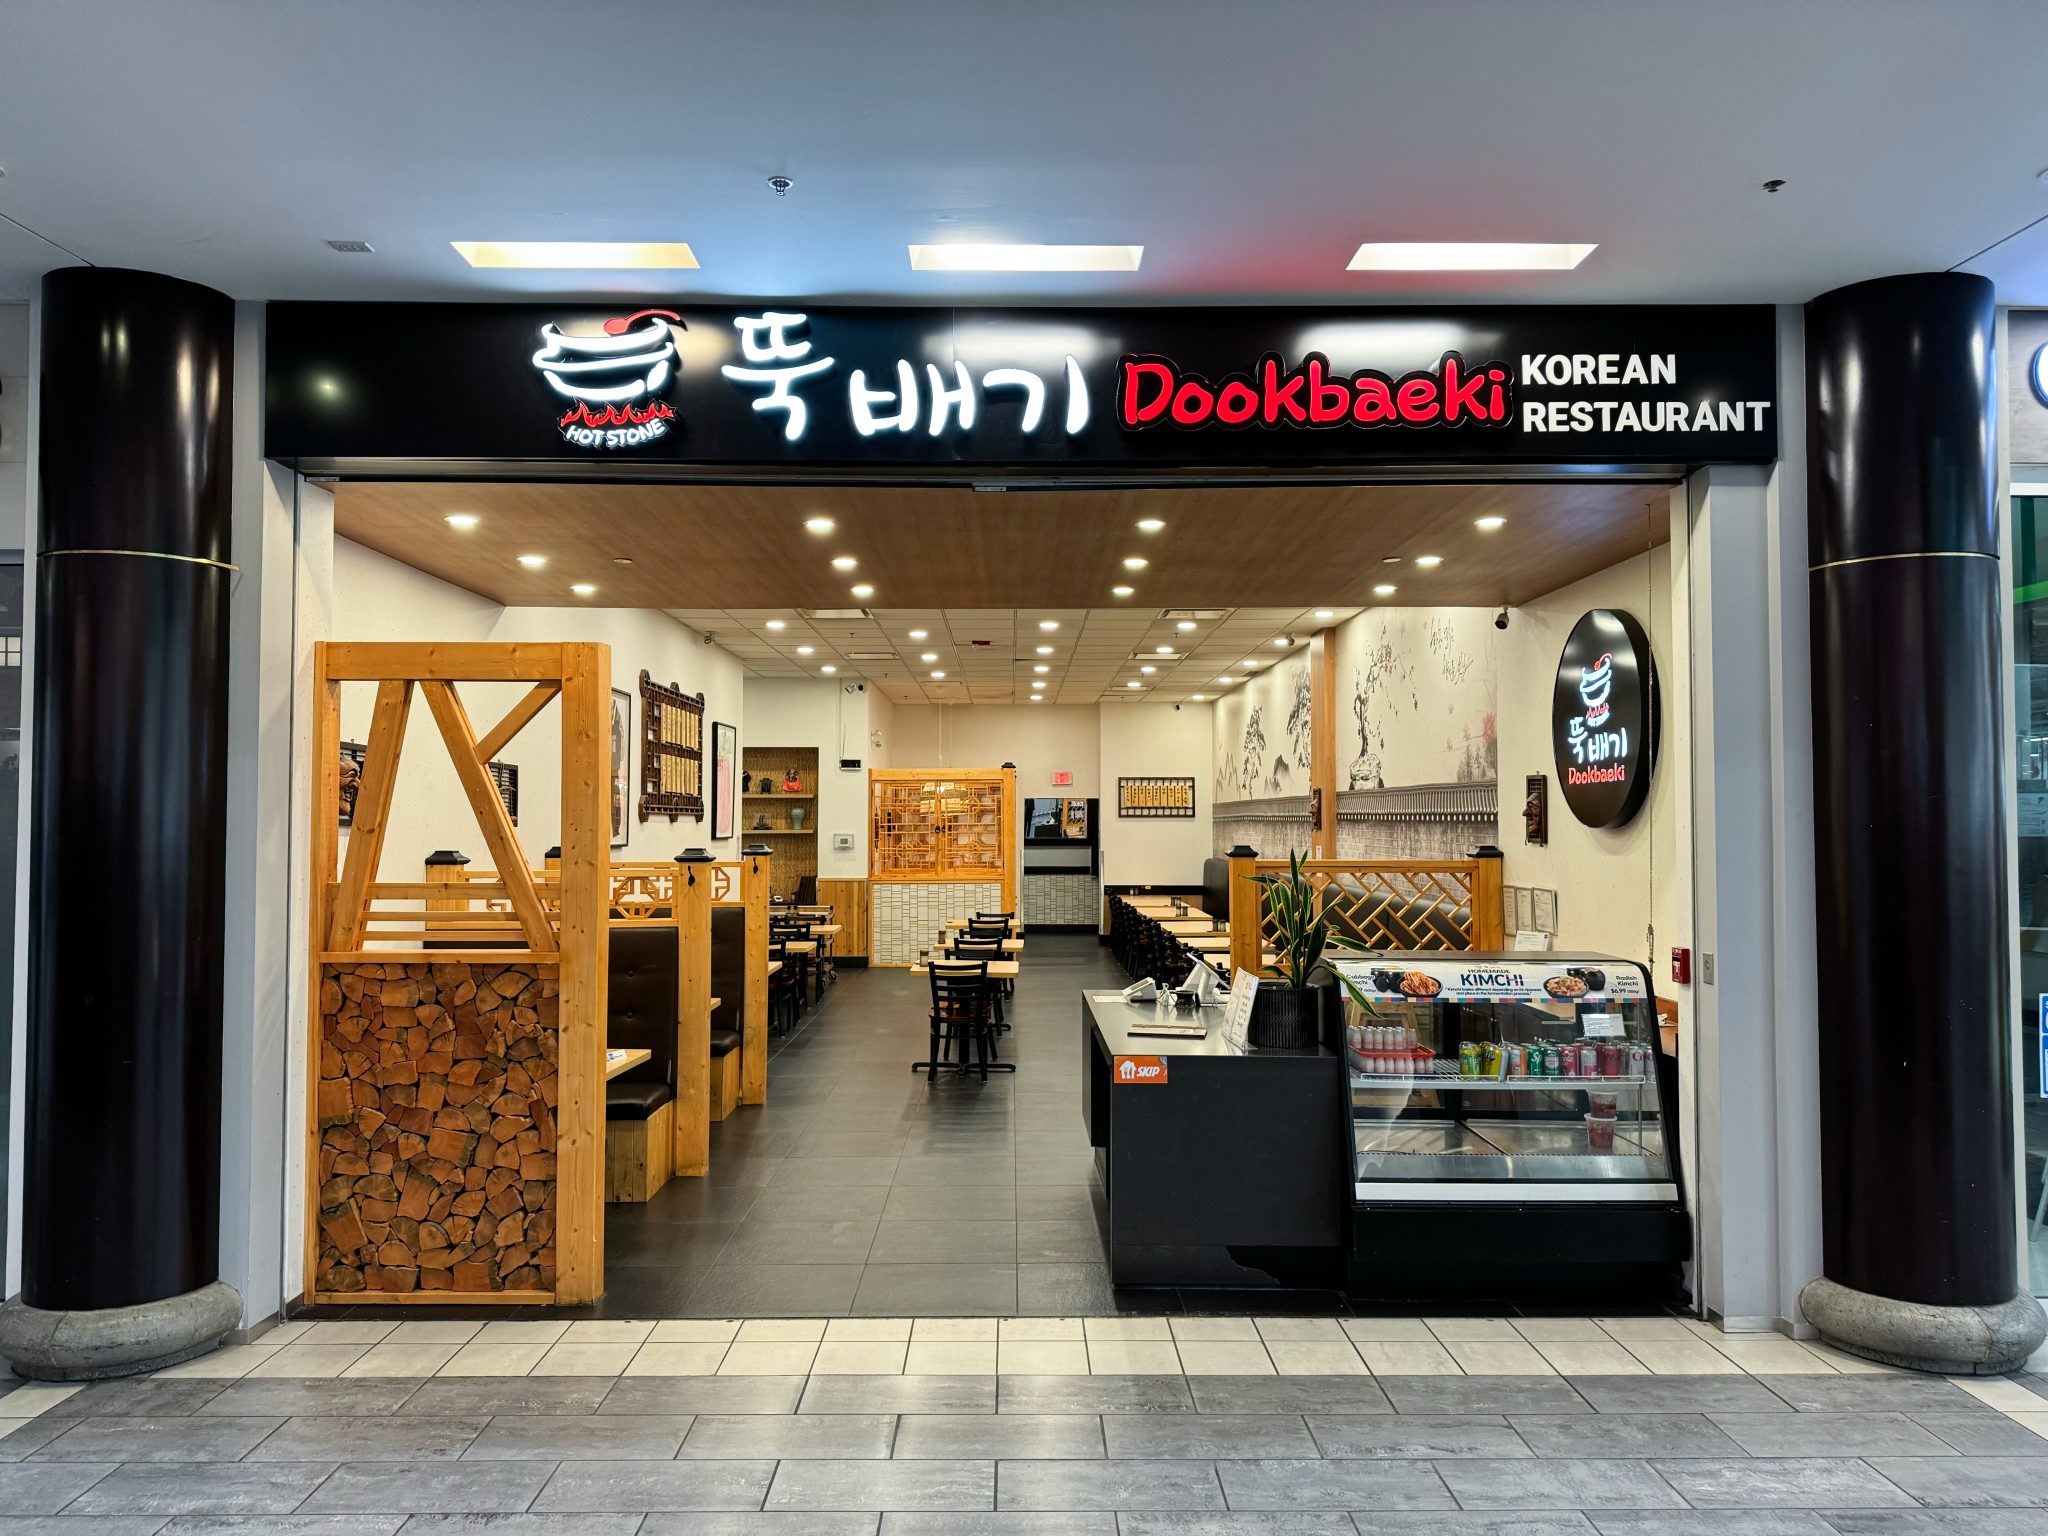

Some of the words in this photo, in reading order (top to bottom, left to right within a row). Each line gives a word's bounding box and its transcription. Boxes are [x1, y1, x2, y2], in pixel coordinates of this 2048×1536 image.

[721, 311, 1090, 441] 뚝배기
[1522, 353, 1677, 386] KOREAN
[1125, 358, 1506, 425] Dookbaeki
[566, 425, 605, 446] HOT
[606, 418, 666, 446] STONE
[1523, 401, 1771, 433] RESTAURANT
[1568, 716, 1627, 763] 뚝배기
[1568, 763, 1625, 784] Dookbaeki
[1460, 974, 1524, 987] KIMCHI
[1136, 1066, 1160, 1077] SKIP
